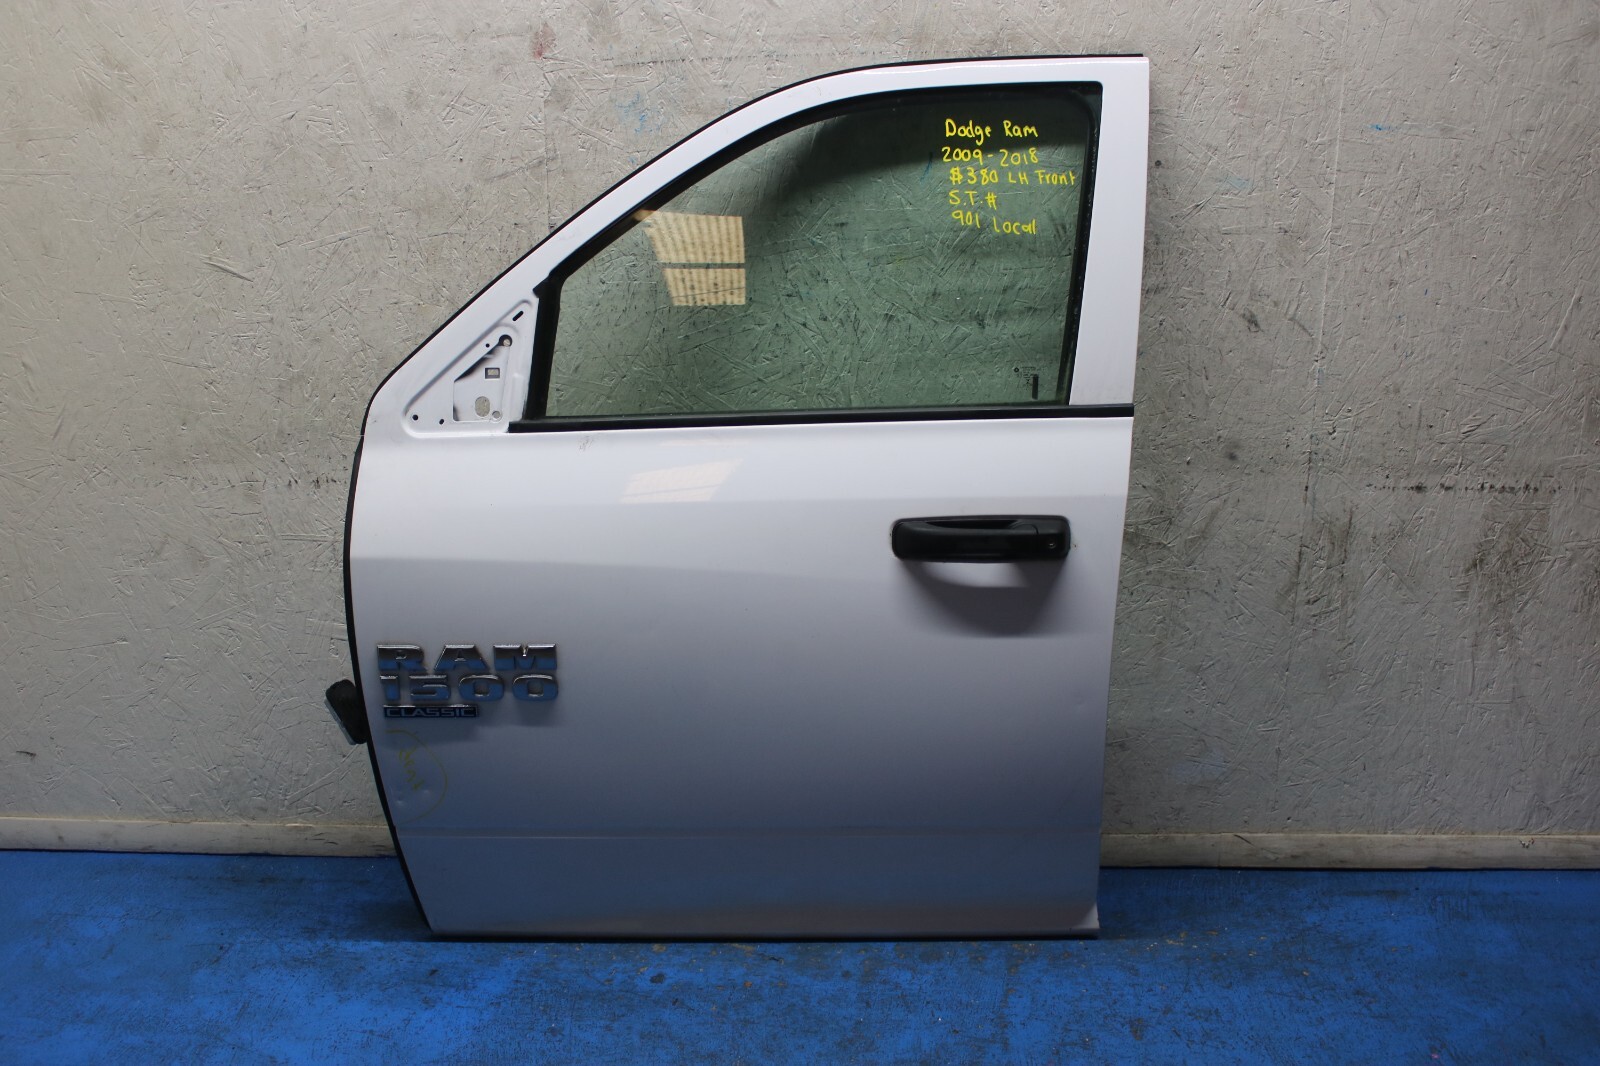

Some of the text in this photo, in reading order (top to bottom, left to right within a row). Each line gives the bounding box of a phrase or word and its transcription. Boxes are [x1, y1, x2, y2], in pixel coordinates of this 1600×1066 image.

[945, 118, 1039, 146] Dodge Ram
[949, 166, 1076, 186] $380 LH Front
[951, 209, 981, 229] 901
[376, 643, 558, 672] RAM
[379, 673, 559, 701] 1500
[384, 705, 477, 718] CLASSIC
